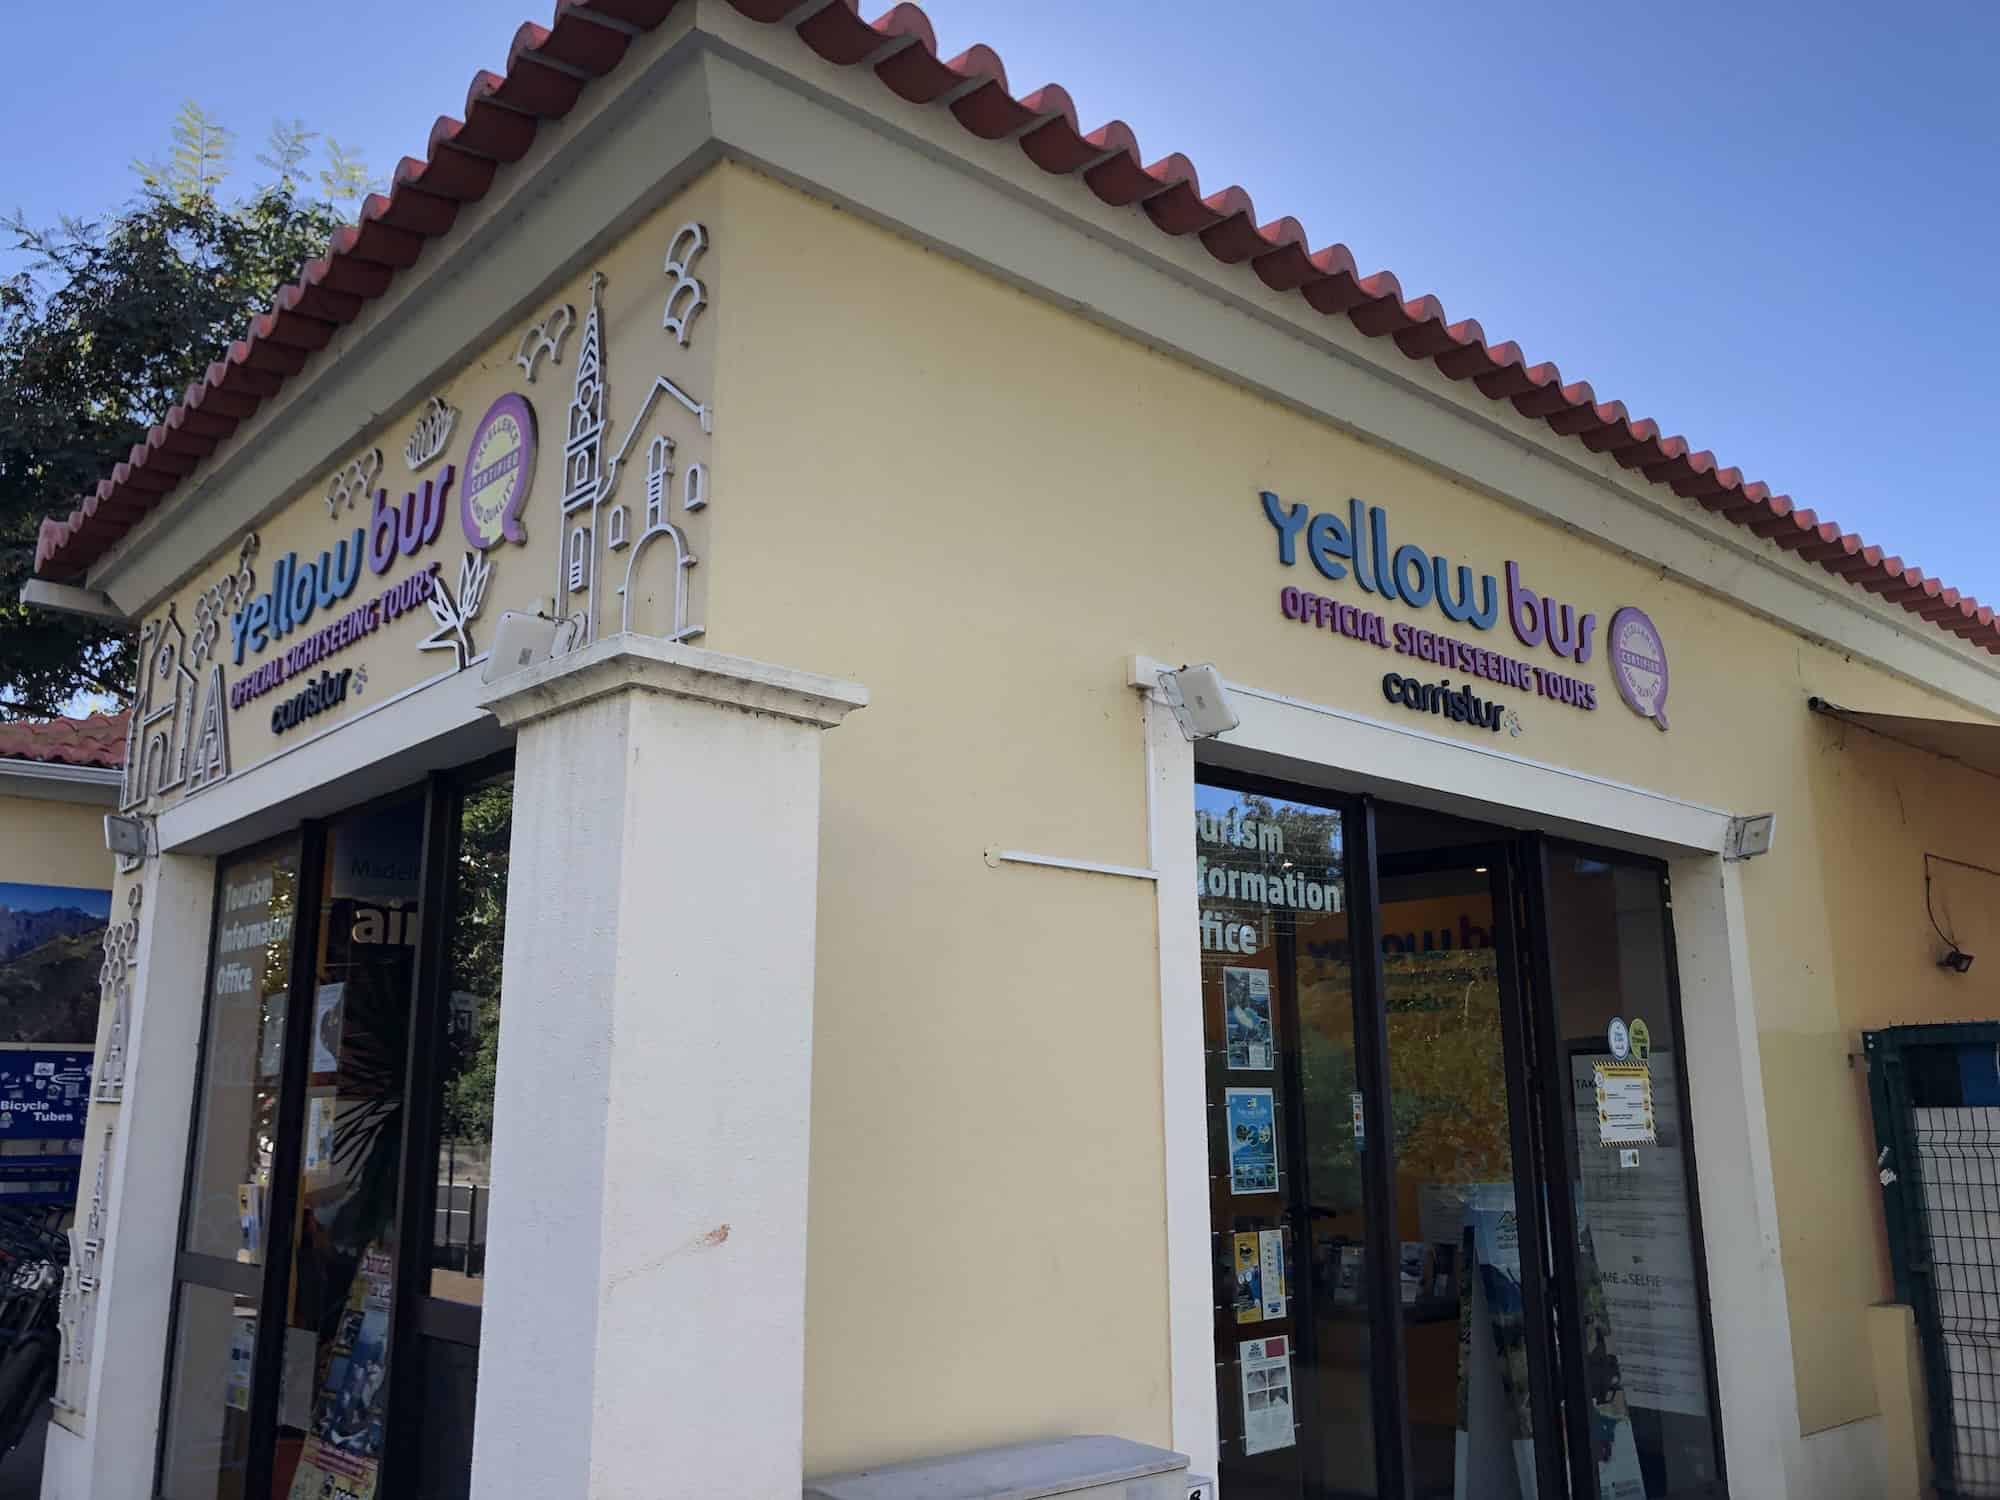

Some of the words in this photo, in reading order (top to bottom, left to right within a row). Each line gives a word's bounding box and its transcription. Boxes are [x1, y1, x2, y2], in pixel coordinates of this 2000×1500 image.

[472, 452, 519, 493] CERTIFIED
[231, 528, 365, 665] Yellow
[368, 464, 456, 576] bus
[1260, 490, 1498, 631] Yellow
[1505, 559, 1596, 664] bus
[230, 656, 284, 711] OFFICIAL
[284, 597, 380, 681] SIGHTSEEING
[379, 561, 441, 625] TOURS
[1281, 586, 1392, 649] OFFICIAL
[1393, 622, 1533, 692] SIGHTSEEING
[1533, 667, 1598, 711] TOURS
[272, 668, 352, 735] carristur
[1382, 672, 1504, 732] carristur
[1197, 813, 1284, 853] urism
[1197, 855, 1341, 912] formation
[1199, 909, 1257, 955] fice
[216, 962, 253, 995] Office
[0, 1100, 50, 1113] Bicycle
[33, 1111, 73, 1121] Tubes
